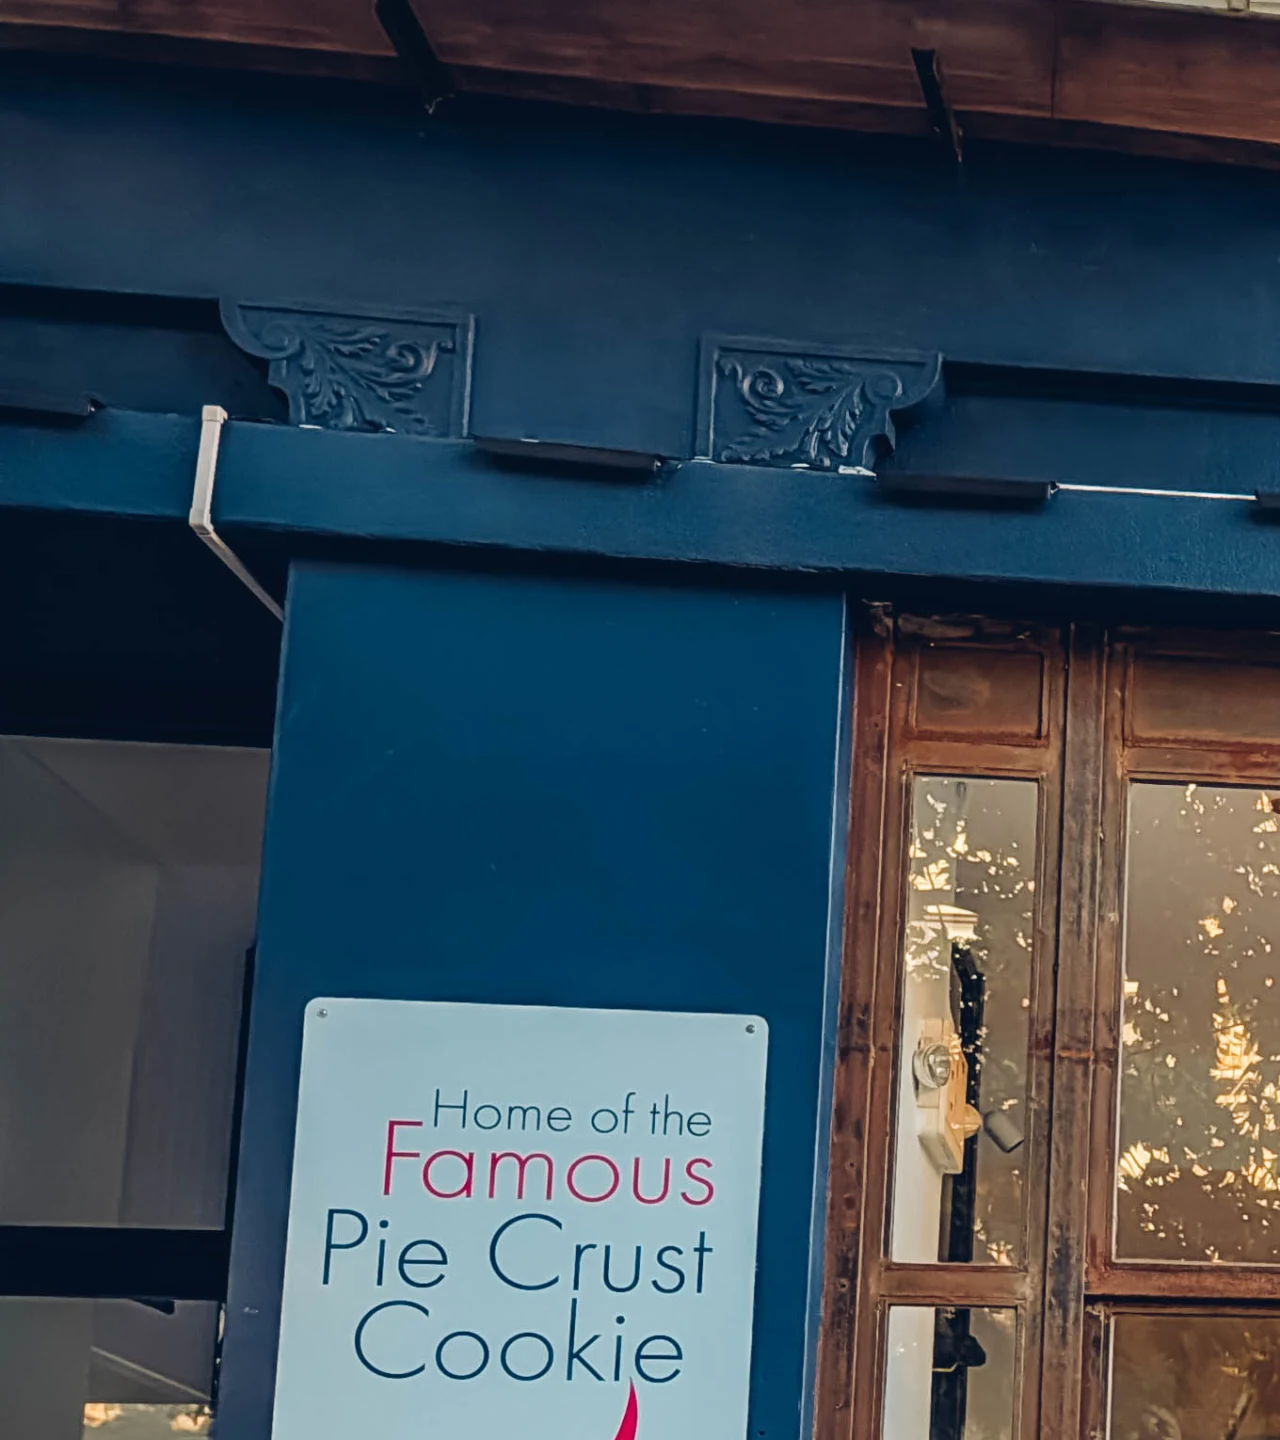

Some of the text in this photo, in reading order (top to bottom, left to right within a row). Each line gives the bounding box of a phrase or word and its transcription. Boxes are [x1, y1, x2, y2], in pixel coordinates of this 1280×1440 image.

[433, 1089, 713, 1137] Home of the
[383, 1119, 715, 1206] Famous
[322, 1208, 713, 1294] Pie Crust
[354, 1298, 684, 1384] Cookie
